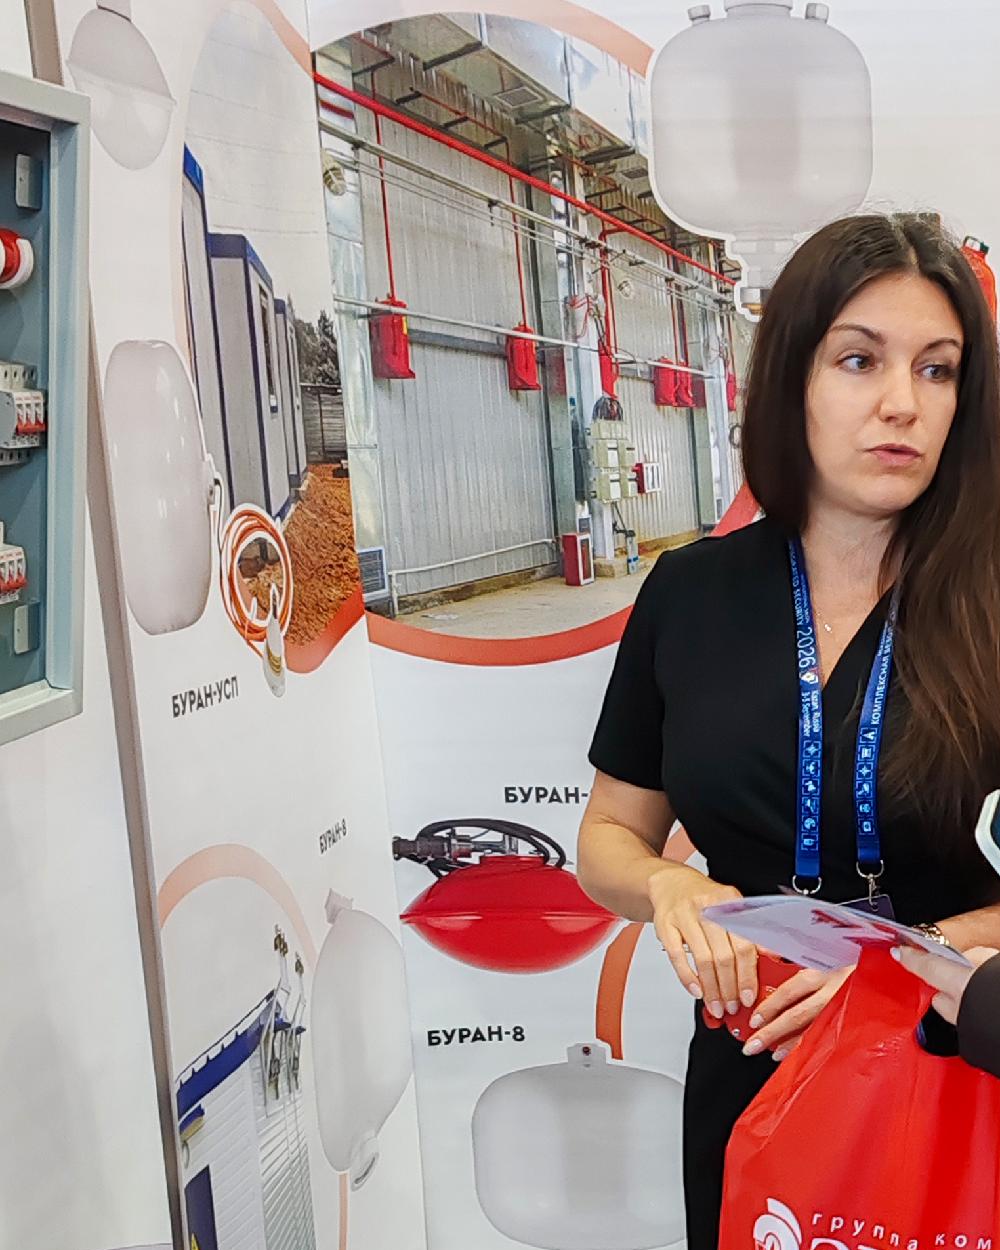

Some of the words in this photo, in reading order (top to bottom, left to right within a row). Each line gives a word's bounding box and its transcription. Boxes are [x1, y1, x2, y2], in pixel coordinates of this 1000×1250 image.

[797, 627, 816, 668] 2026
[172, 675, 239, 718] БУРАН-УСП
[870, 656, 890, 726] КОМПЛЕКСНАЯ
[504, 786, 589, 804] БУРАН-
[319, 818, 347, 855] БУРАН-8
[427, 1025, 526, 1047] БУРАН-8
